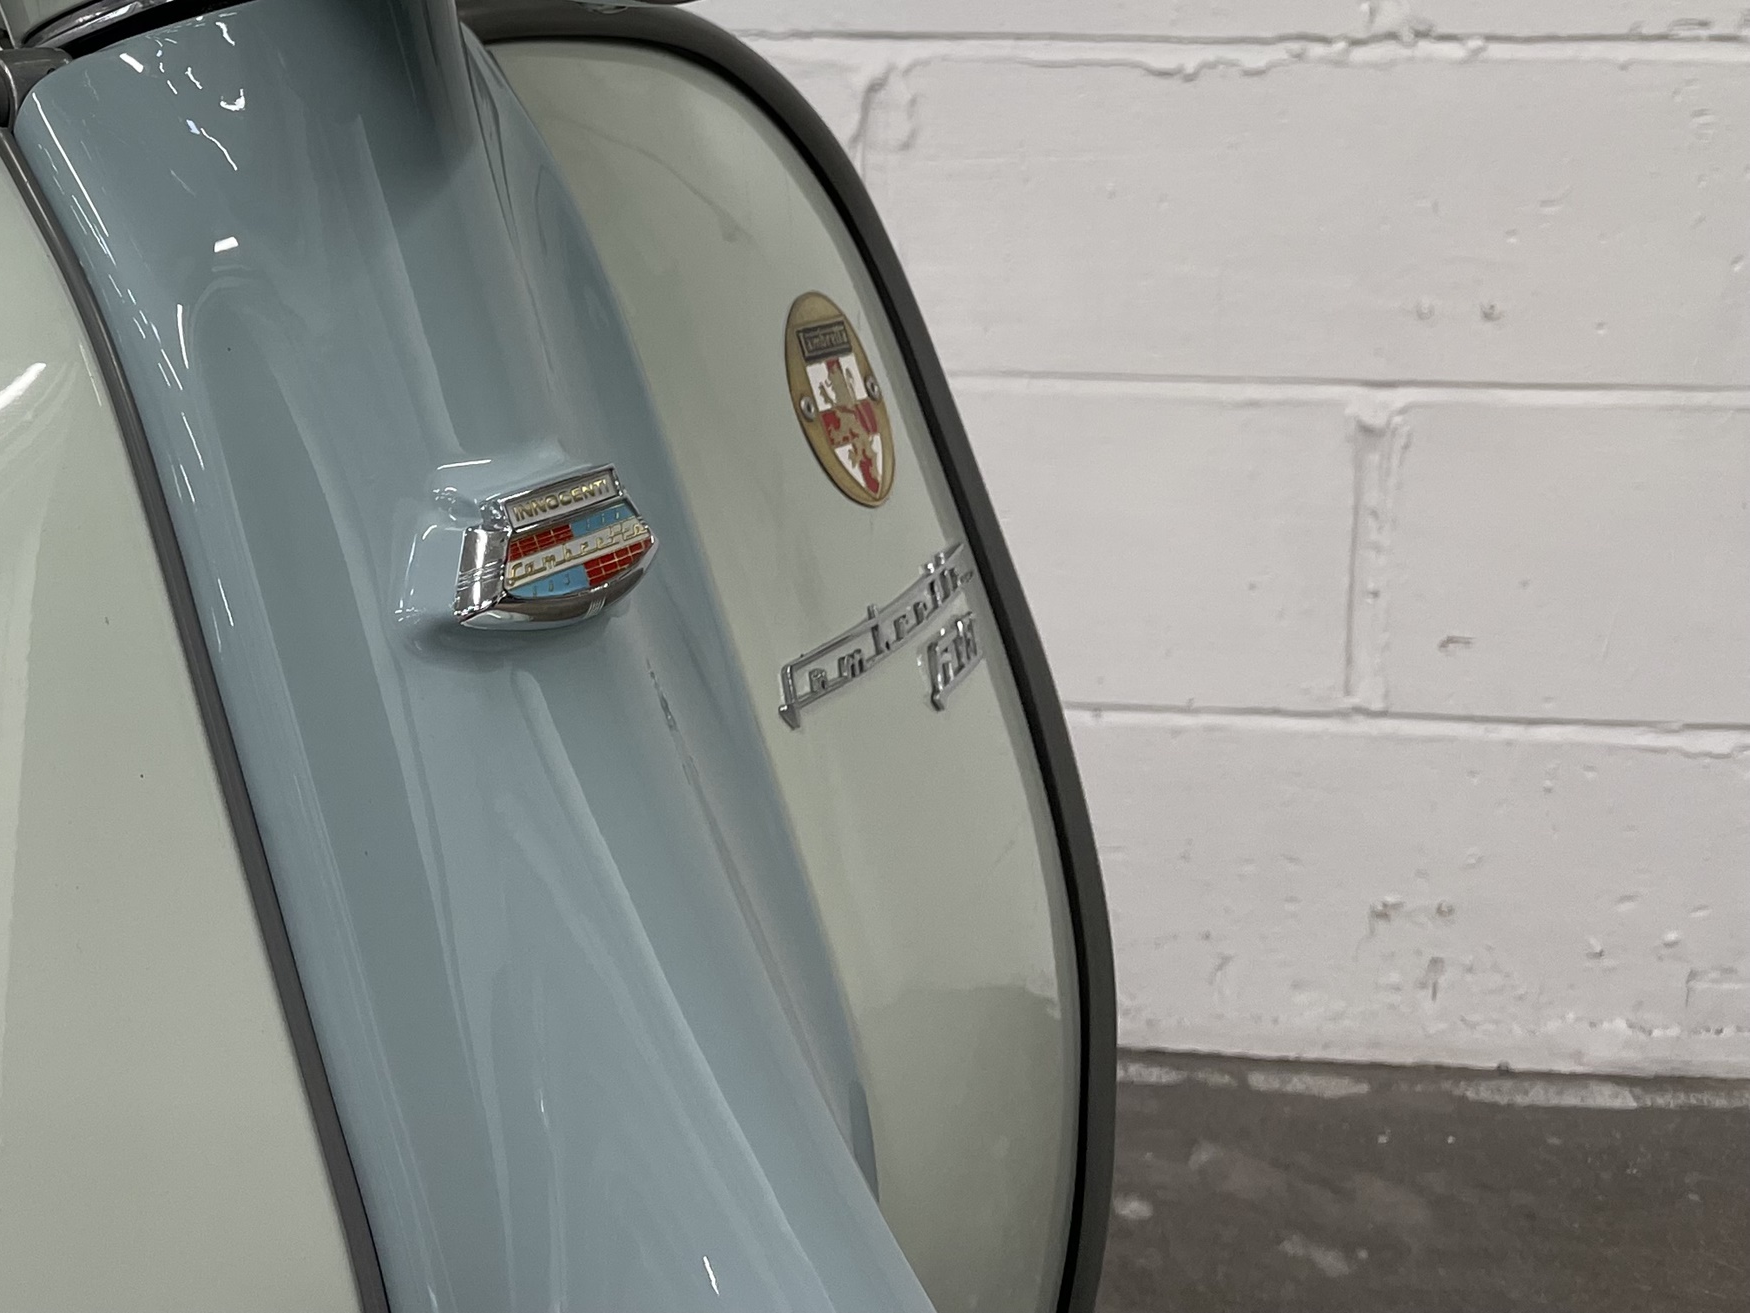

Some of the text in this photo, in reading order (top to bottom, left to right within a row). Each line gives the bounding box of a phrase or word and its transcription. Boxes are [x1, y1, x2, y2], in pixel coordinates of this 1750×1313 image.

[512, 478, 611, 523] INNOCENTI
[506, 522, 648, 586] Lambretta
[778, 542, 974, 730] Lambretta
